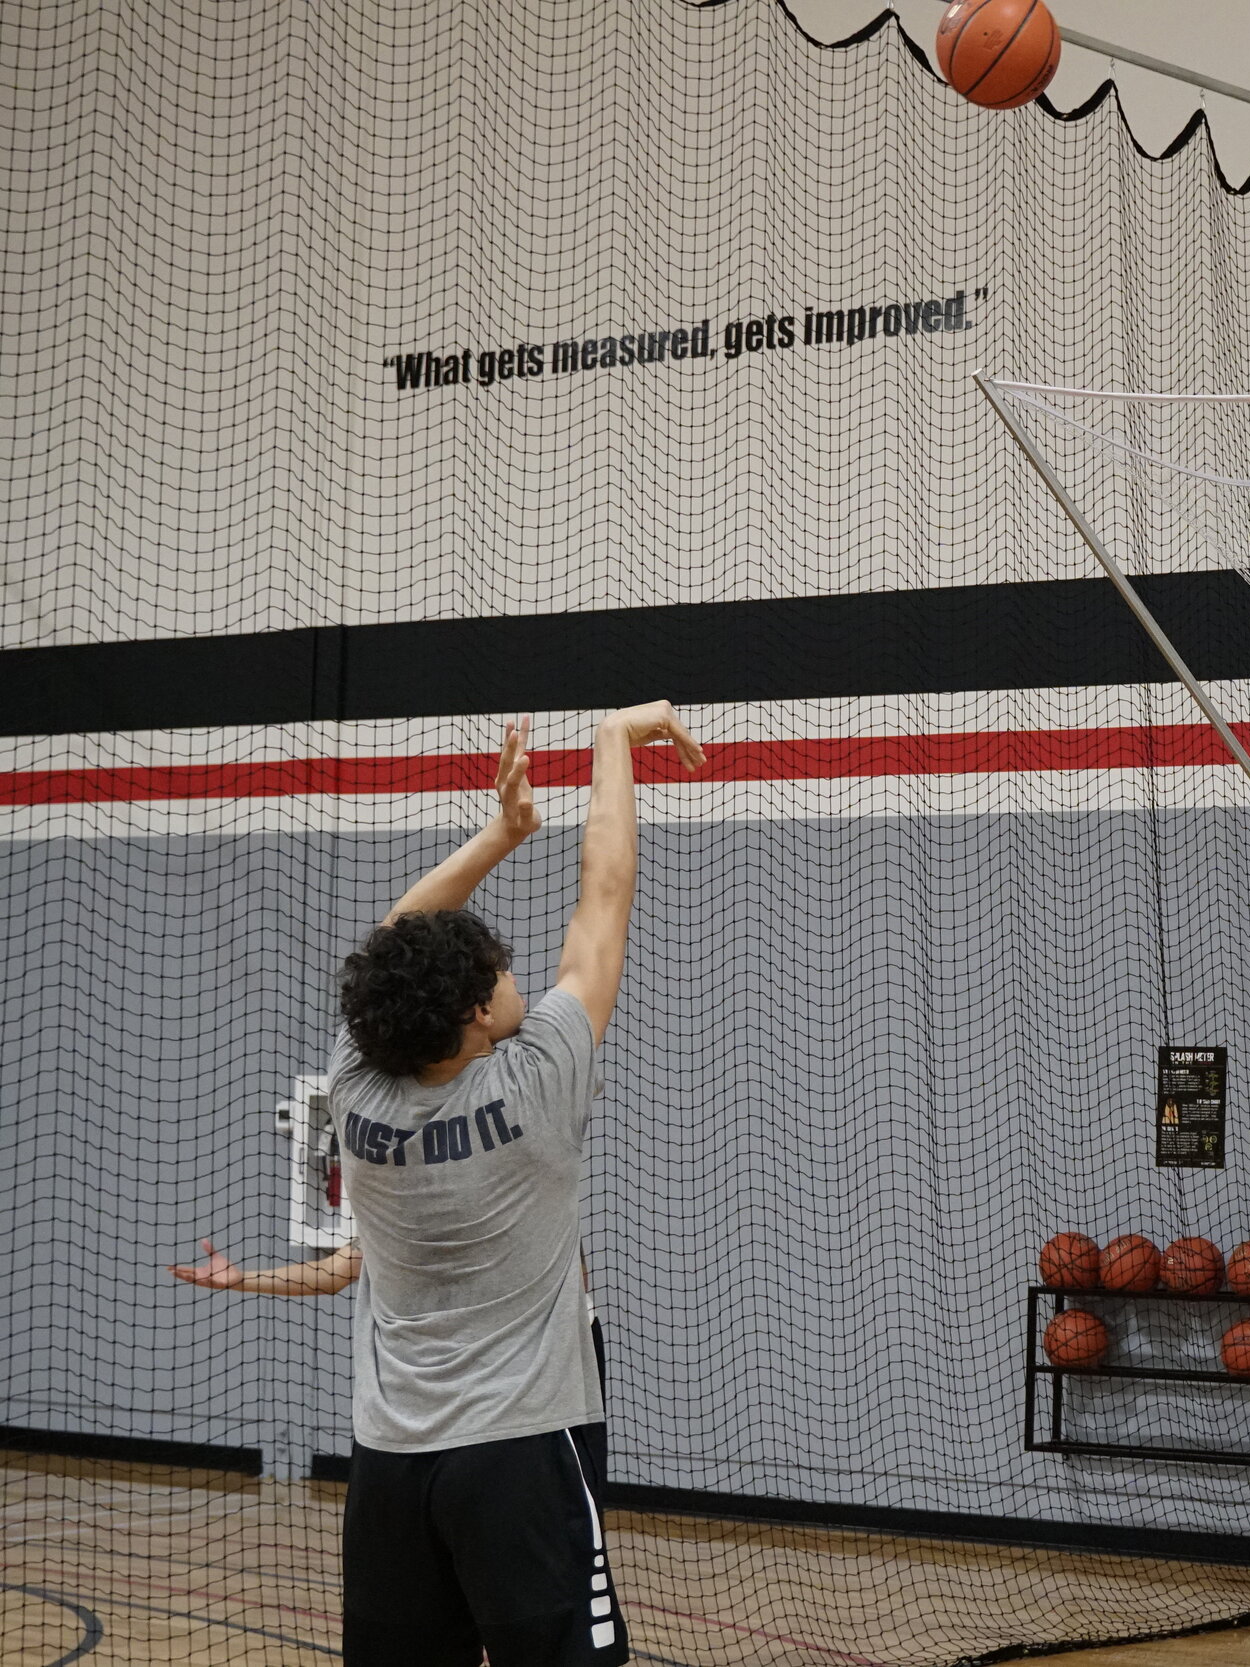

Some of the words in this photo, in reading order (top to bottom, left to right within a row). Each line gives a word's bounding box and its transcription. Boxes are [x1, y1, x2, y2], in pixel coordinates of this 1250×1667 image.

[479, 344, 544, 386] gets
[552, 318, 718, 373] measured,
[724, 314, 795, 359] gets
[422, 1115, 473, 1165] DO
[475, 1098, 523, 1152] IT.
